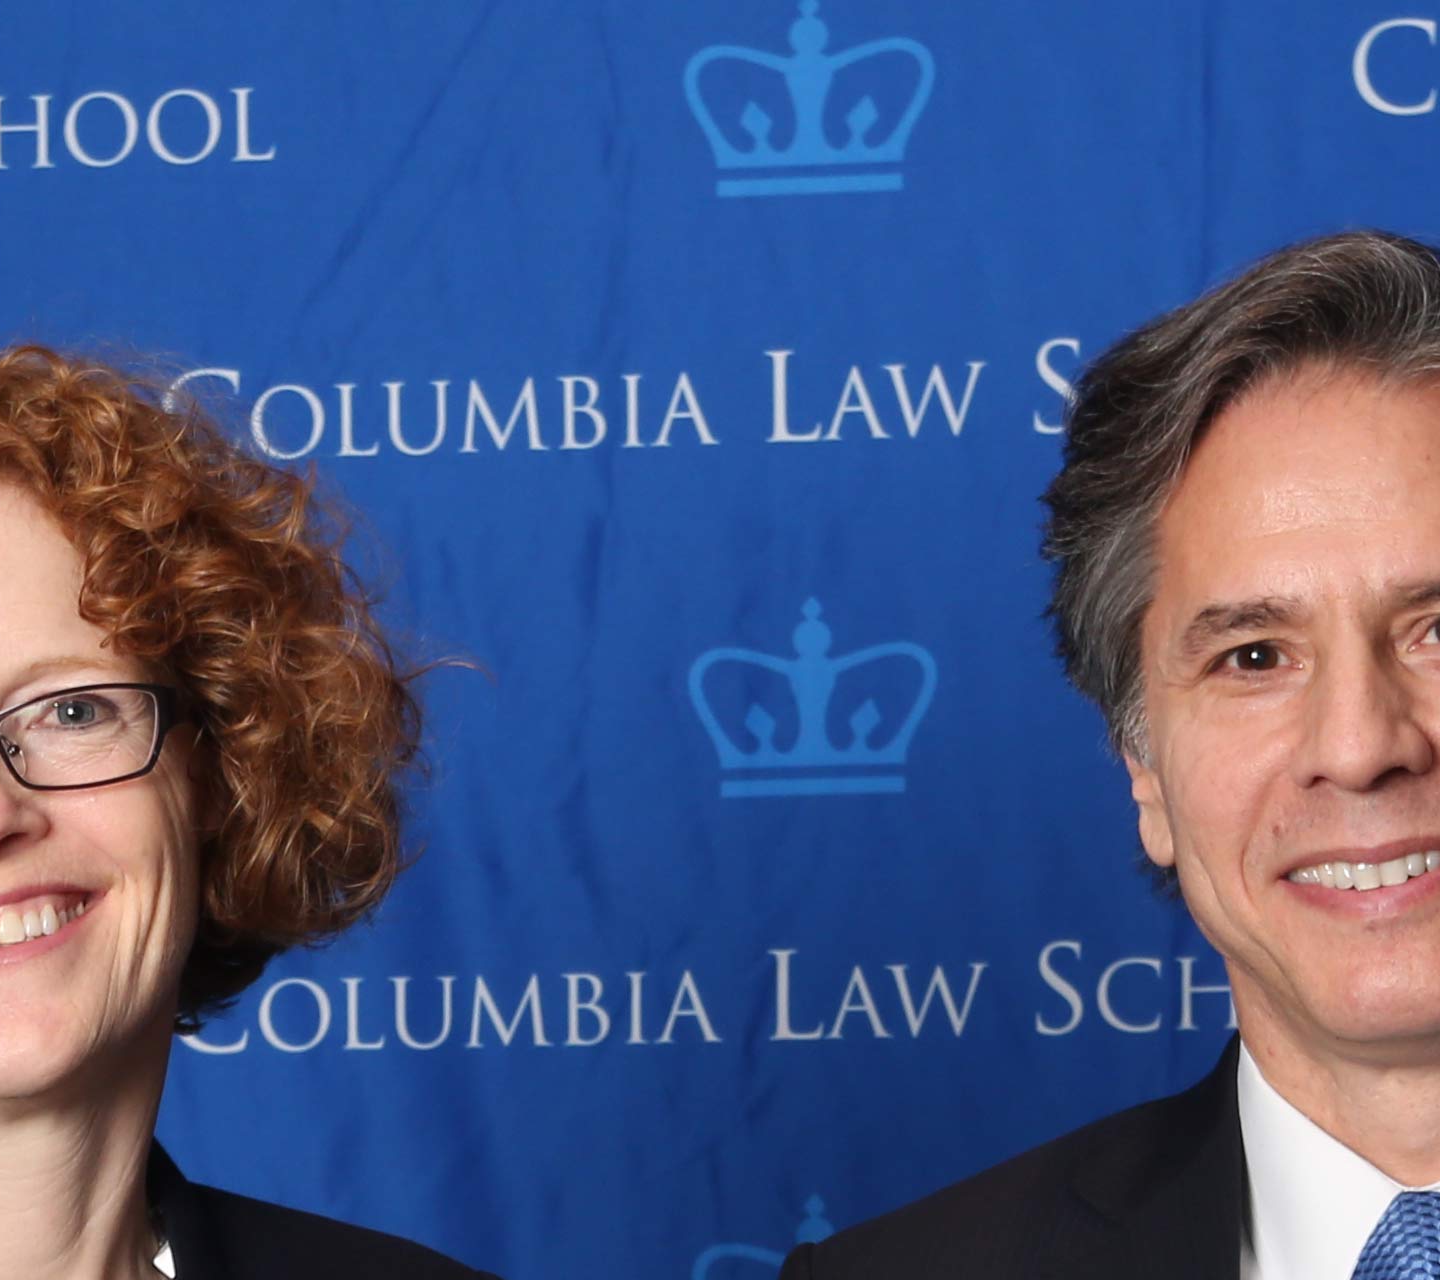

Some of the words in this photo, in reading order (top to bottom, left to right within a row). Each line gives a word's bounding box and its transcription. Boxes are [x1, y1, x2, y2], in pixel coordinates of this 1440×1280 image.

[766, 347, 987, 443] LAW
[174, 968, 724, 1056] OLUMBIA
[766, 947, 989, 1041] LAW
